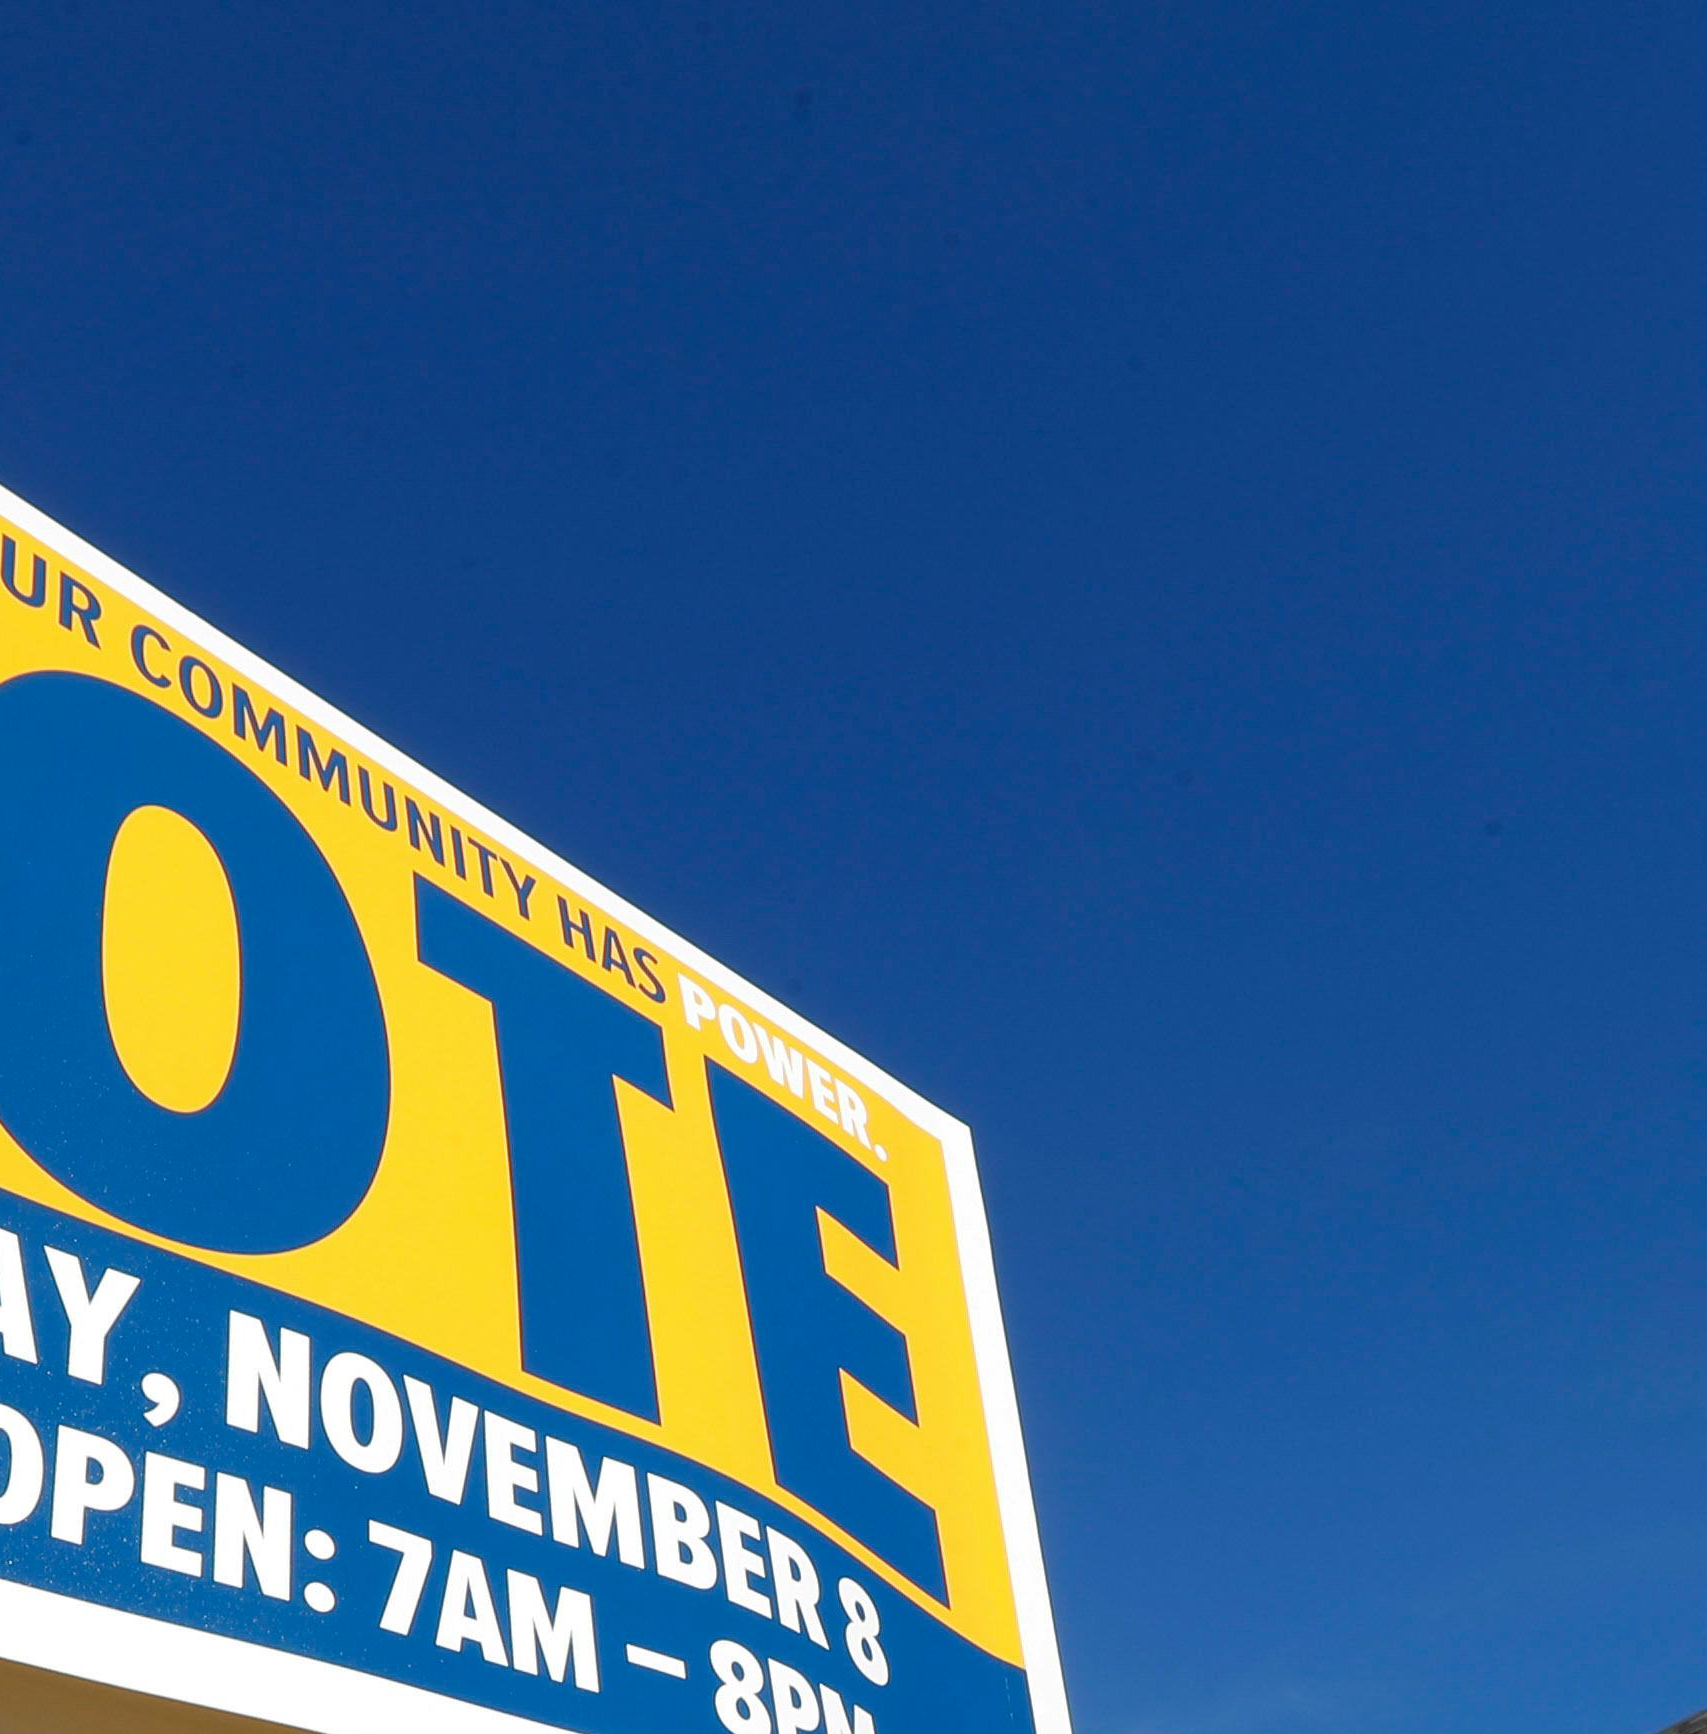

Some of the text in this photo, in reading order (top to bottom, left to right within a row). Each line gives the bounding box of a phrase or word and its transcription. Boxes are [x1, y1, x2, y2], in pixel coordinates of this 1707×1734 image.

[130, 624, 537, 921] COMMUNITY
[557, 895, 667, 1003] HAS
[677, 971, 889, 1162] POWER.
[225, 1308, 830, 1651] NOVEMBER
[838, 1576, 891, 1687] 8
[368, 1519, 601, 1694] 7AM
